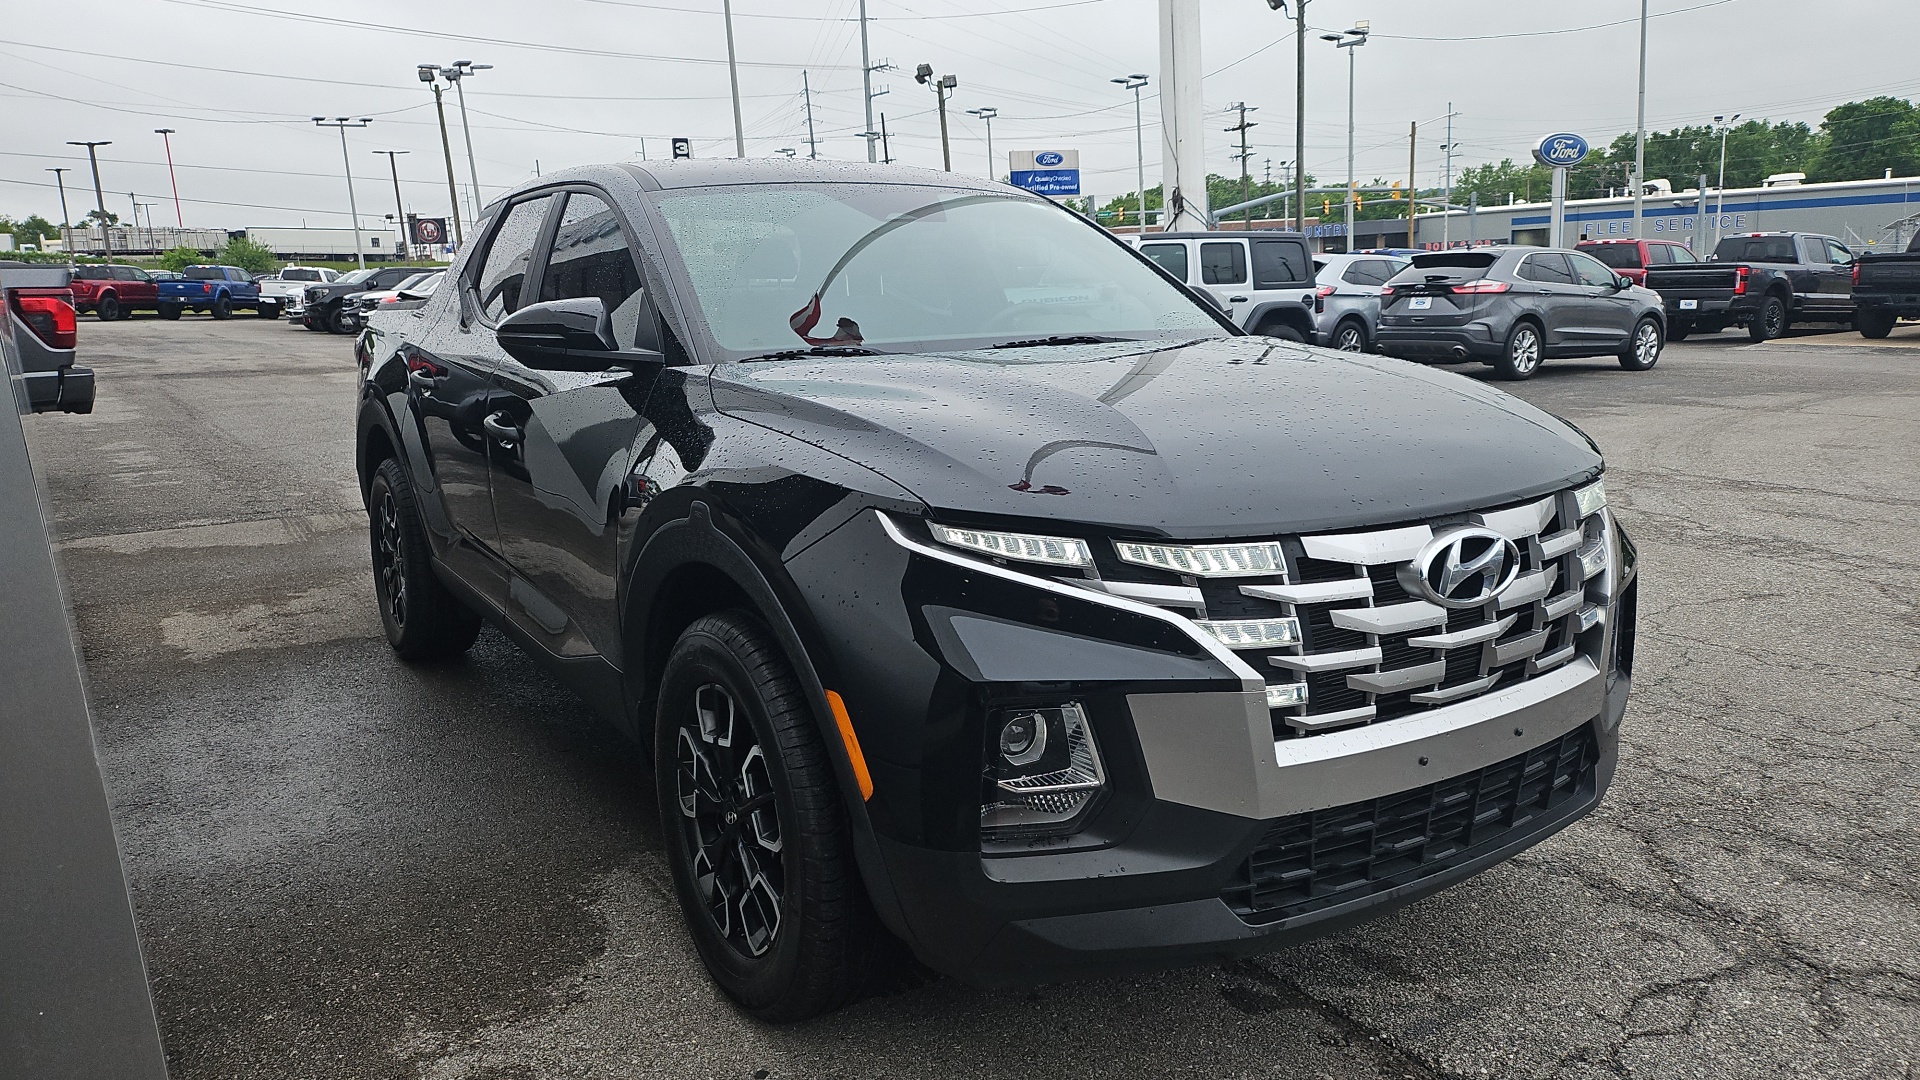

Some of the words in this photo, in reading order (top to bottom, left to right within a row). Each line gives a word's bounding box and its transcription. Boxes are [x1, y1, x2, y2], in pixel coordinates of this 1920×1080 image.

[675, 142, 688, 155] 3
[1550, 139, 1581, 159] Ford
[1042, 154, 1060, 164] Ford
[1049, 183, 1078, 191] Pre-owned
[1584, 219, 1644, 236] FLEE
[1653, 213, 1747, 233] SERICE
